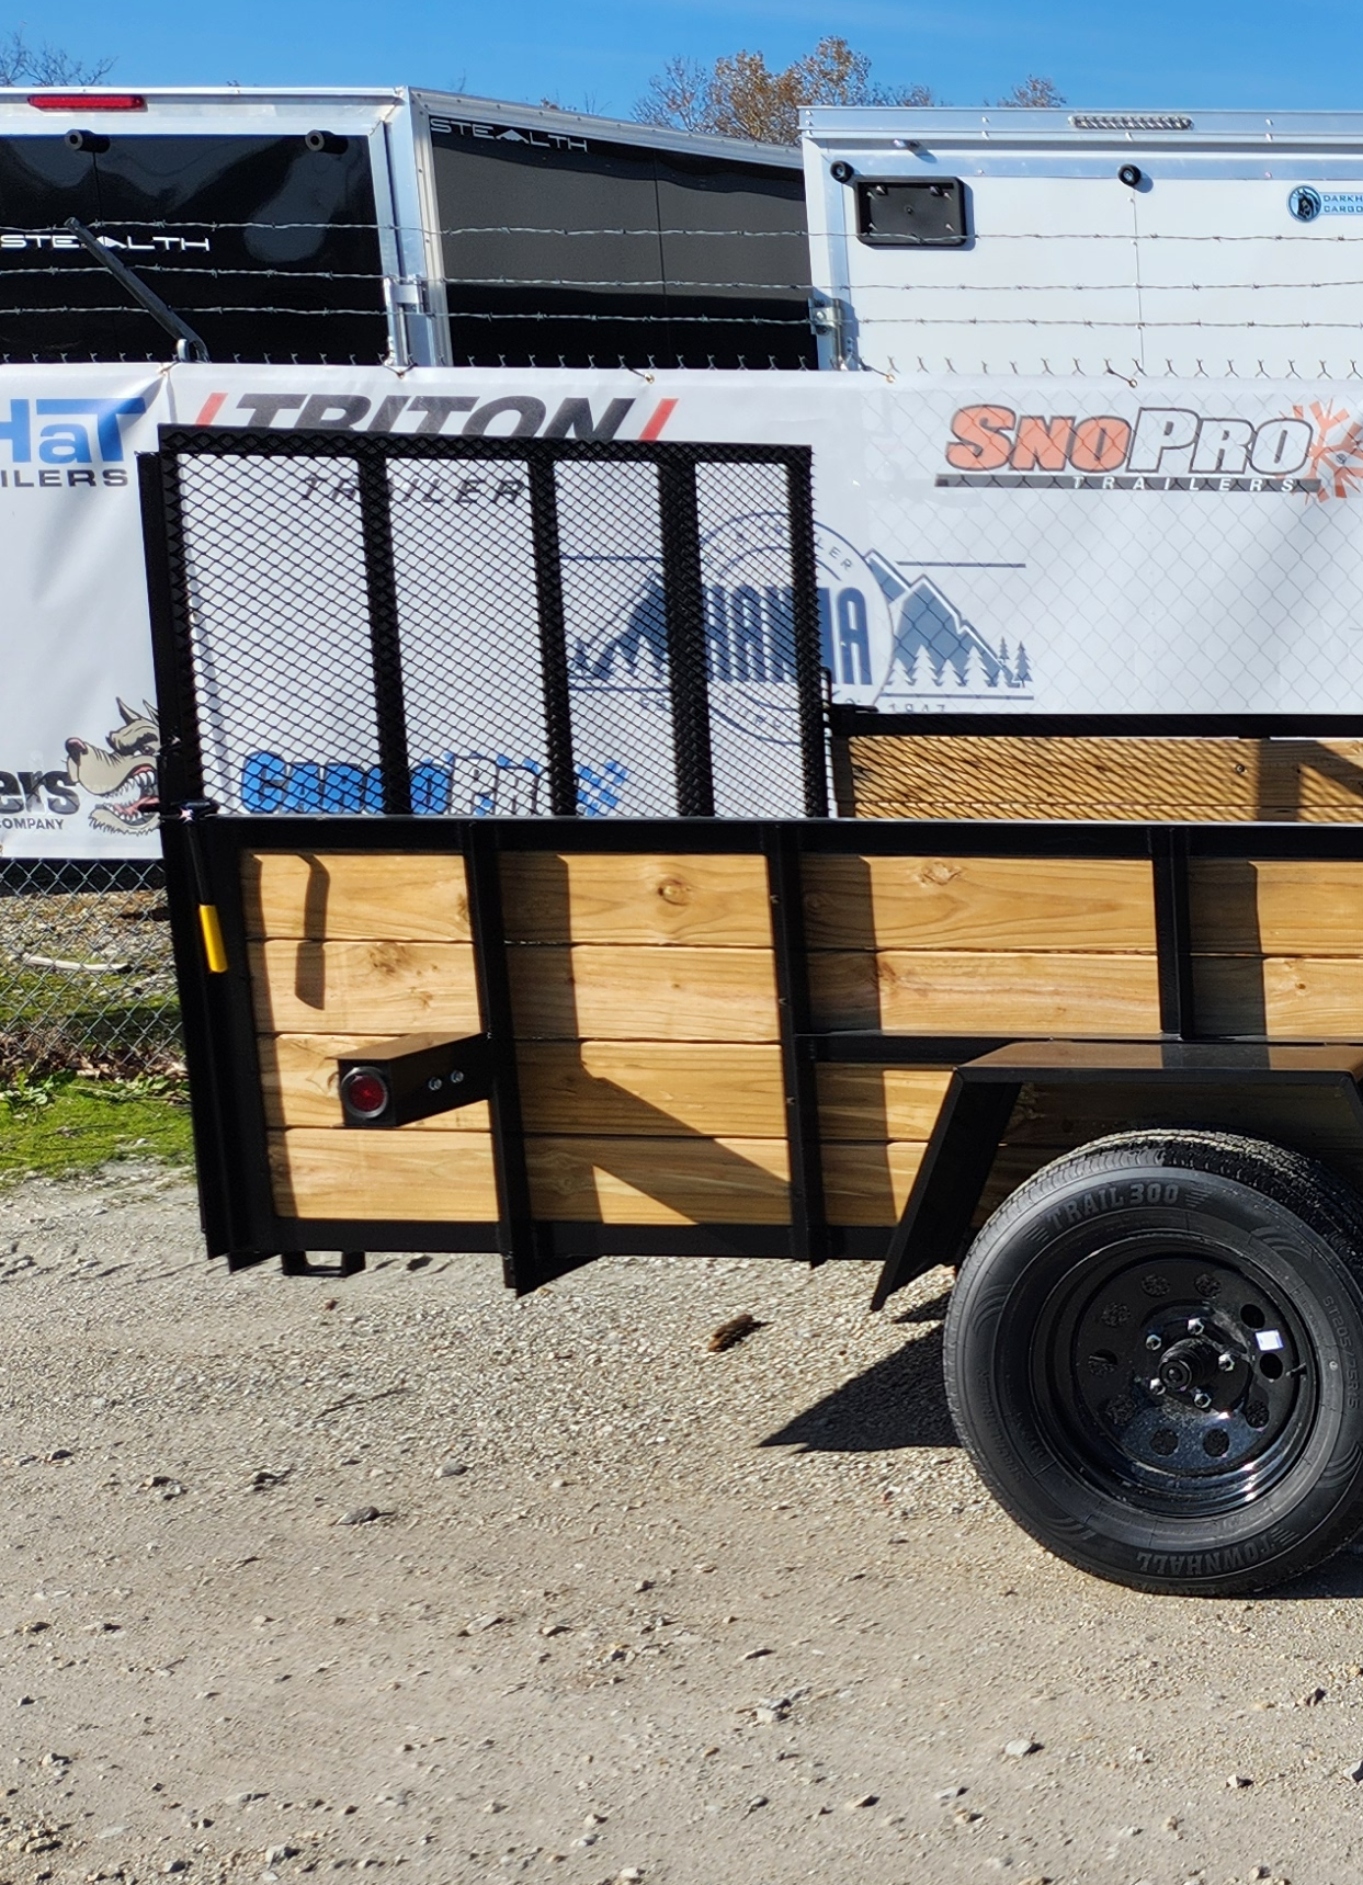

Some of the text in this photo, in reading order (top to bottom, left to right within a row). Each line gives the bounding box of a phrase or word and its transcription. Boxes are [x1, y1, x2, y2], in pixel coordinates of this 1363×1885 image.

[430, 118, 588, 152] STEALTH
[1323, 205, 1363, 213] CARGO
[0, 234, 210, 252] STEALTH
[235, 393, 637, 441] TRITON
[1072, 475, 1297, 492] TRAILERS
[1046, 1183, 1180, 1230] TRAIL 300
[1136, 1533, 1275, 1575] TOWNHALL
